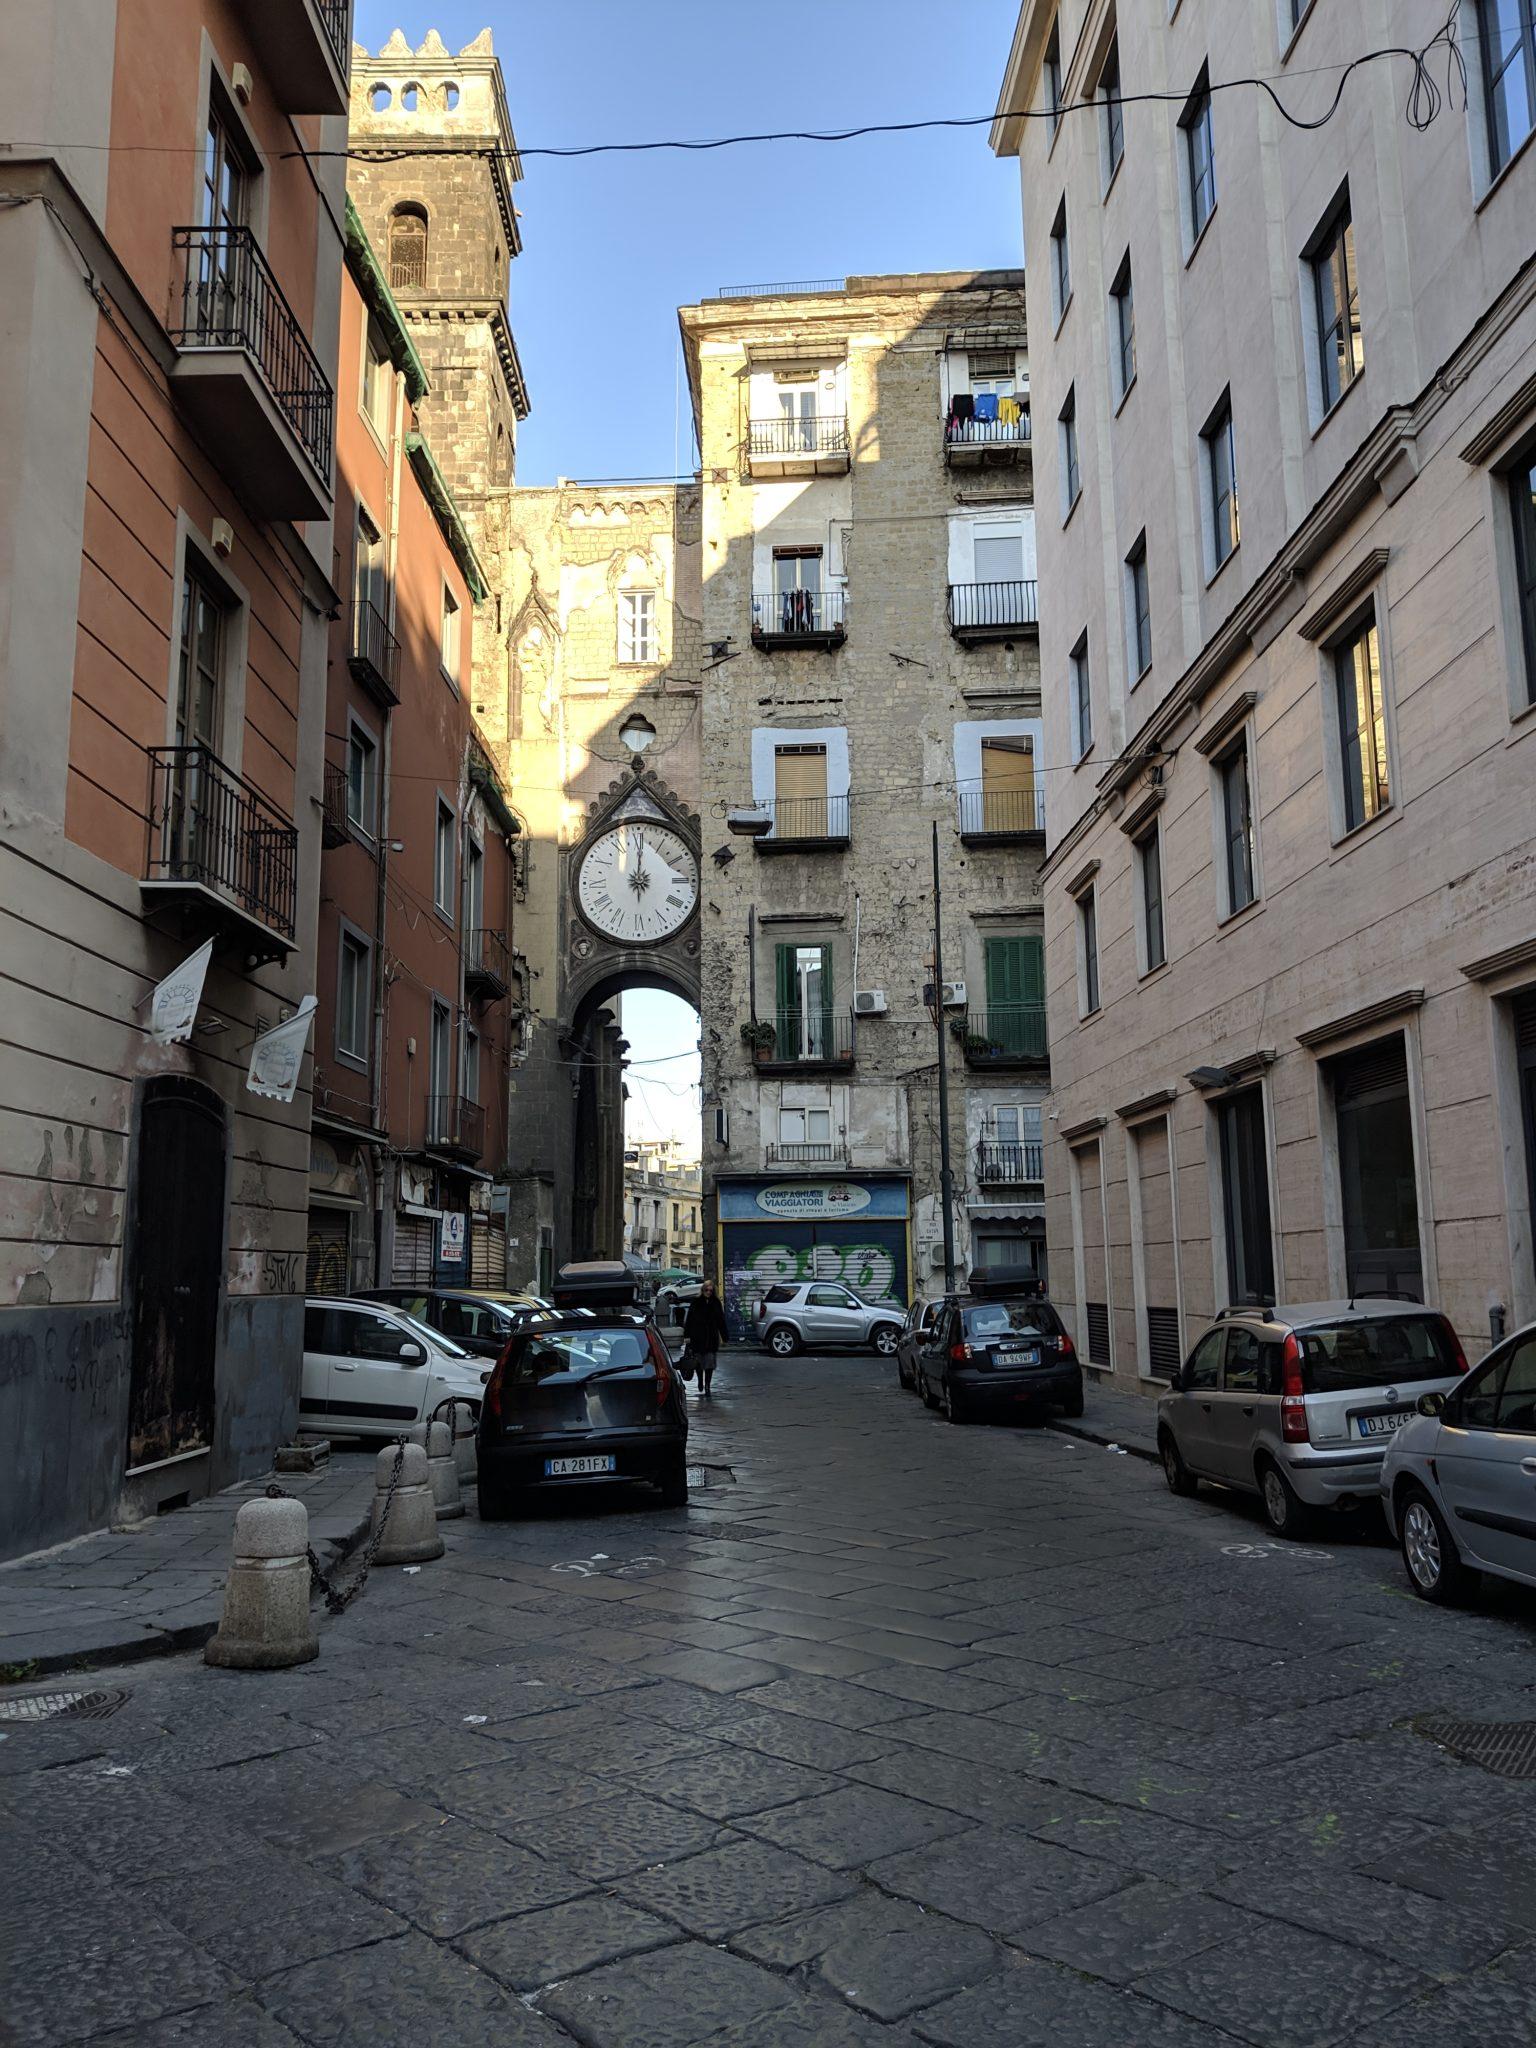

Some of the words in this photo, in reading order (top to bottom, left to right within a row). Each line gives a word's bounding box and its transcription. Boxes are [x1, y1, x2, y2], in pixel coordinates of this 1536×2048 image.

[764, 1198, 824, 1207] VIAGGIATORI
[998, 1355, 1007, 1364] DA
[1367, 1416, 1385, 1432] DJ
[553, 1461, 567, 1473] CA
[571, 1457, 608, 1472] 281FX
